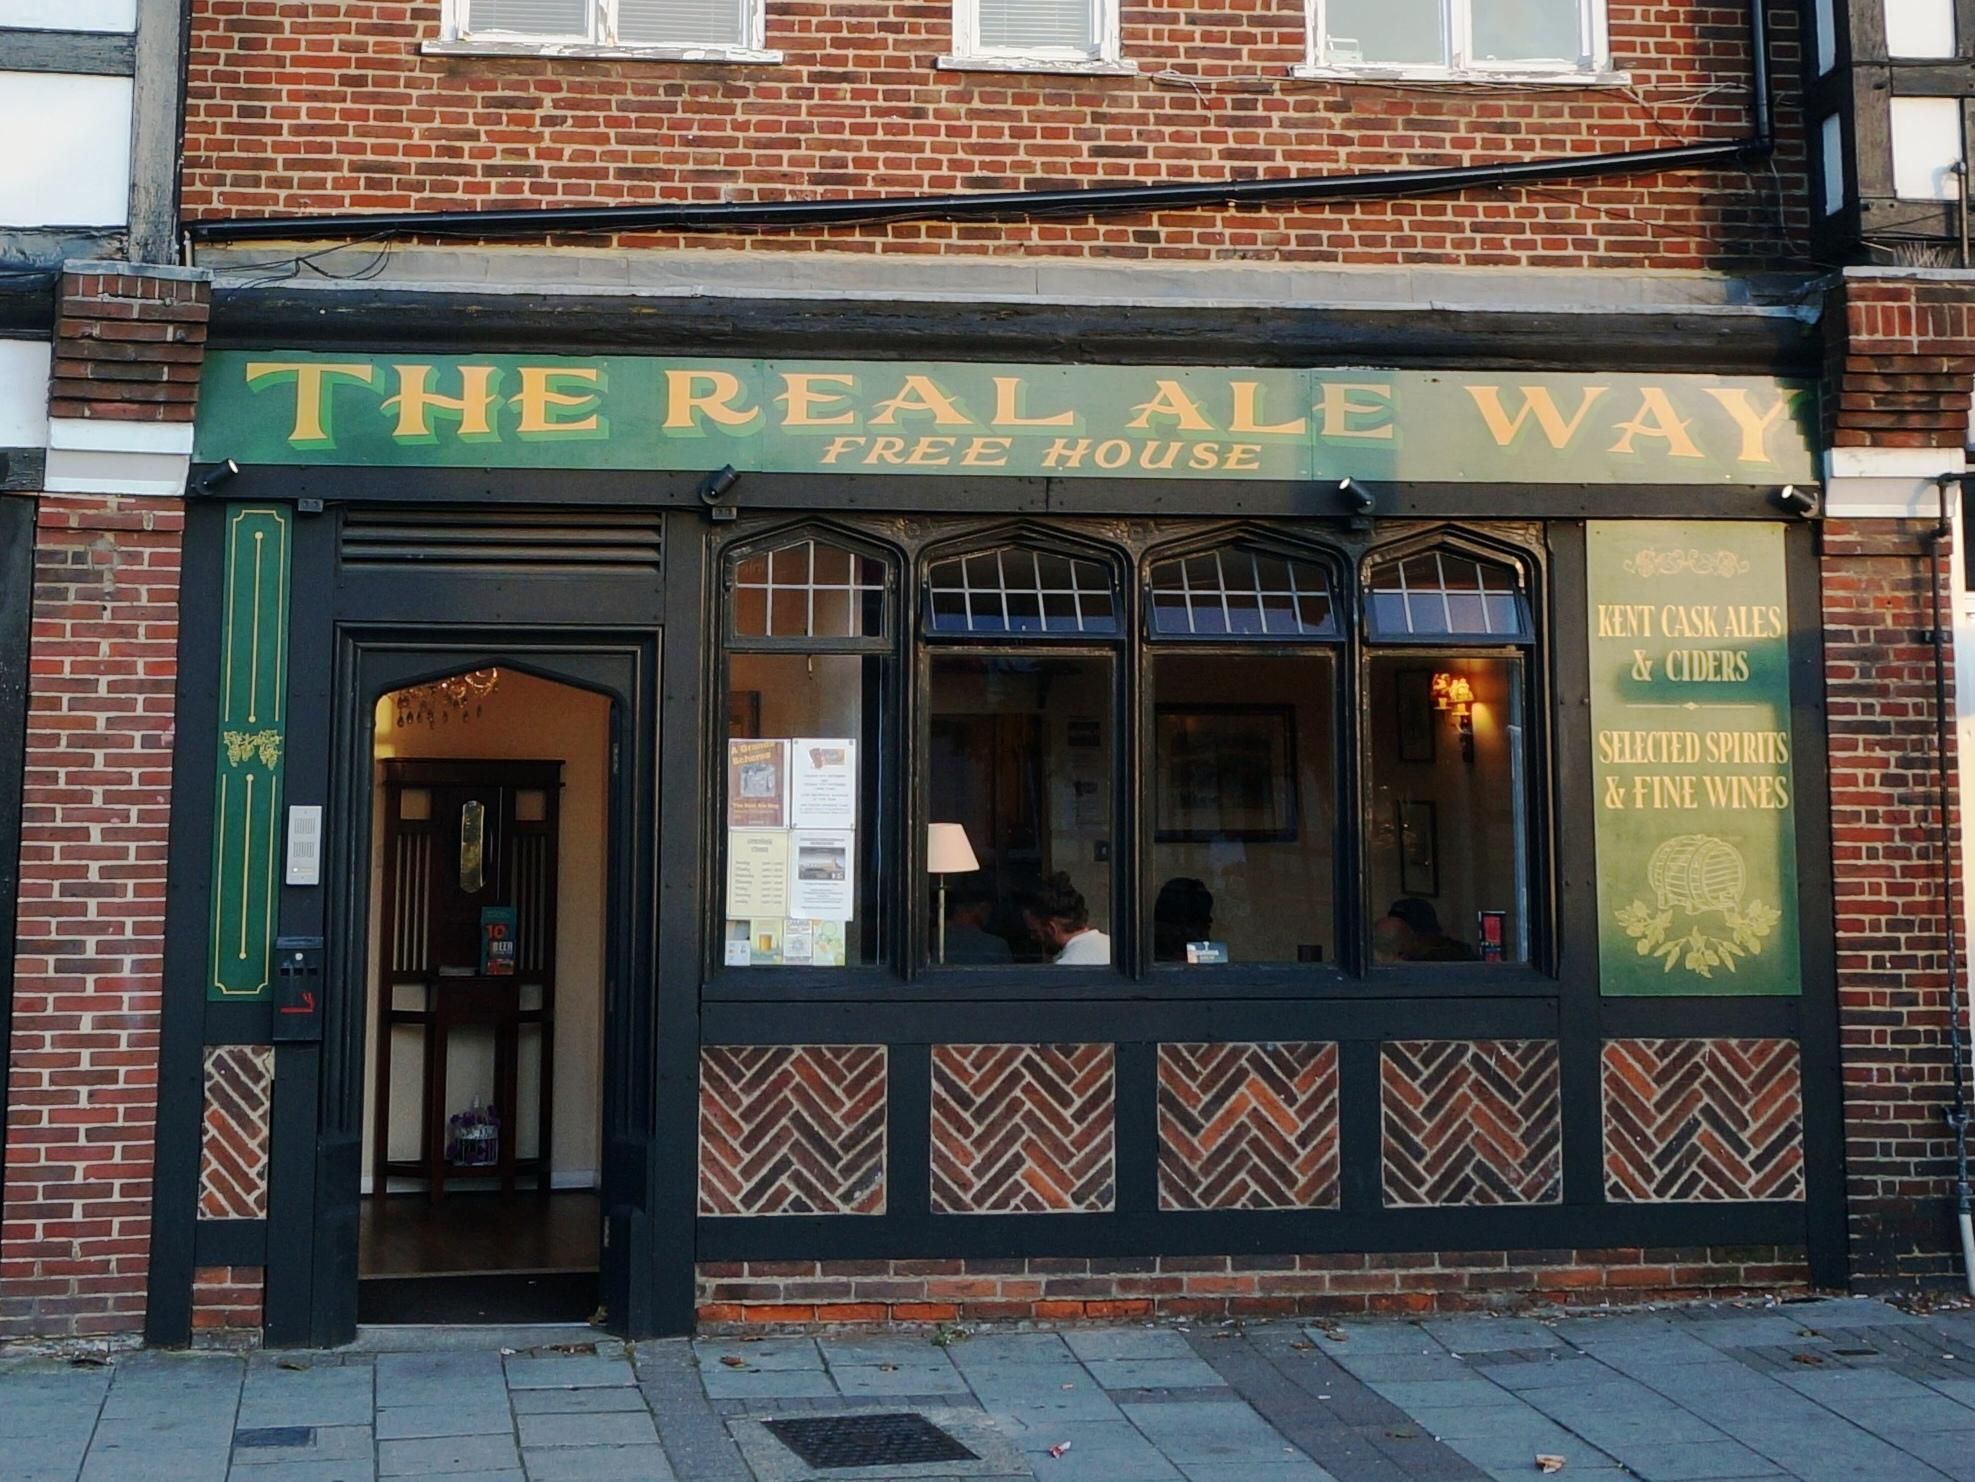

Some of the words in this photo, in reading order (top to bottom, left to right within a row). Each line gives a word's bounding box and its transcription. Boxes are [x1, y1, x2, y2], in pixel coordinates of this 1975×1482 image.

[246, 362, 606, 446] THE
[662, 369, 1074, 434] REAL
[1130, 379, 1393, 440] ALE
[1464, 385, 1803, 463] WAY
[821, 436, 1011, 469] FREE
[1042, 439, 1262, 471] HOUSE
[1598, 604, 1655, 637] KENT
[1661, 604, 1719, 638] CASK
[1724, 606, 1782, 638] ALES
[1631, 650, 1653, 681] &
[1665, 650, 1749, 682] CIDERS
[1600, 730, 1700, 763] SELECTED
[1706, 731, 1789, 763] SPIRITS
[1605, 776, 1625, 809] &
[1632, 776, 1698, 808] FINE
[1703, 776, 1789, 809] WINES
